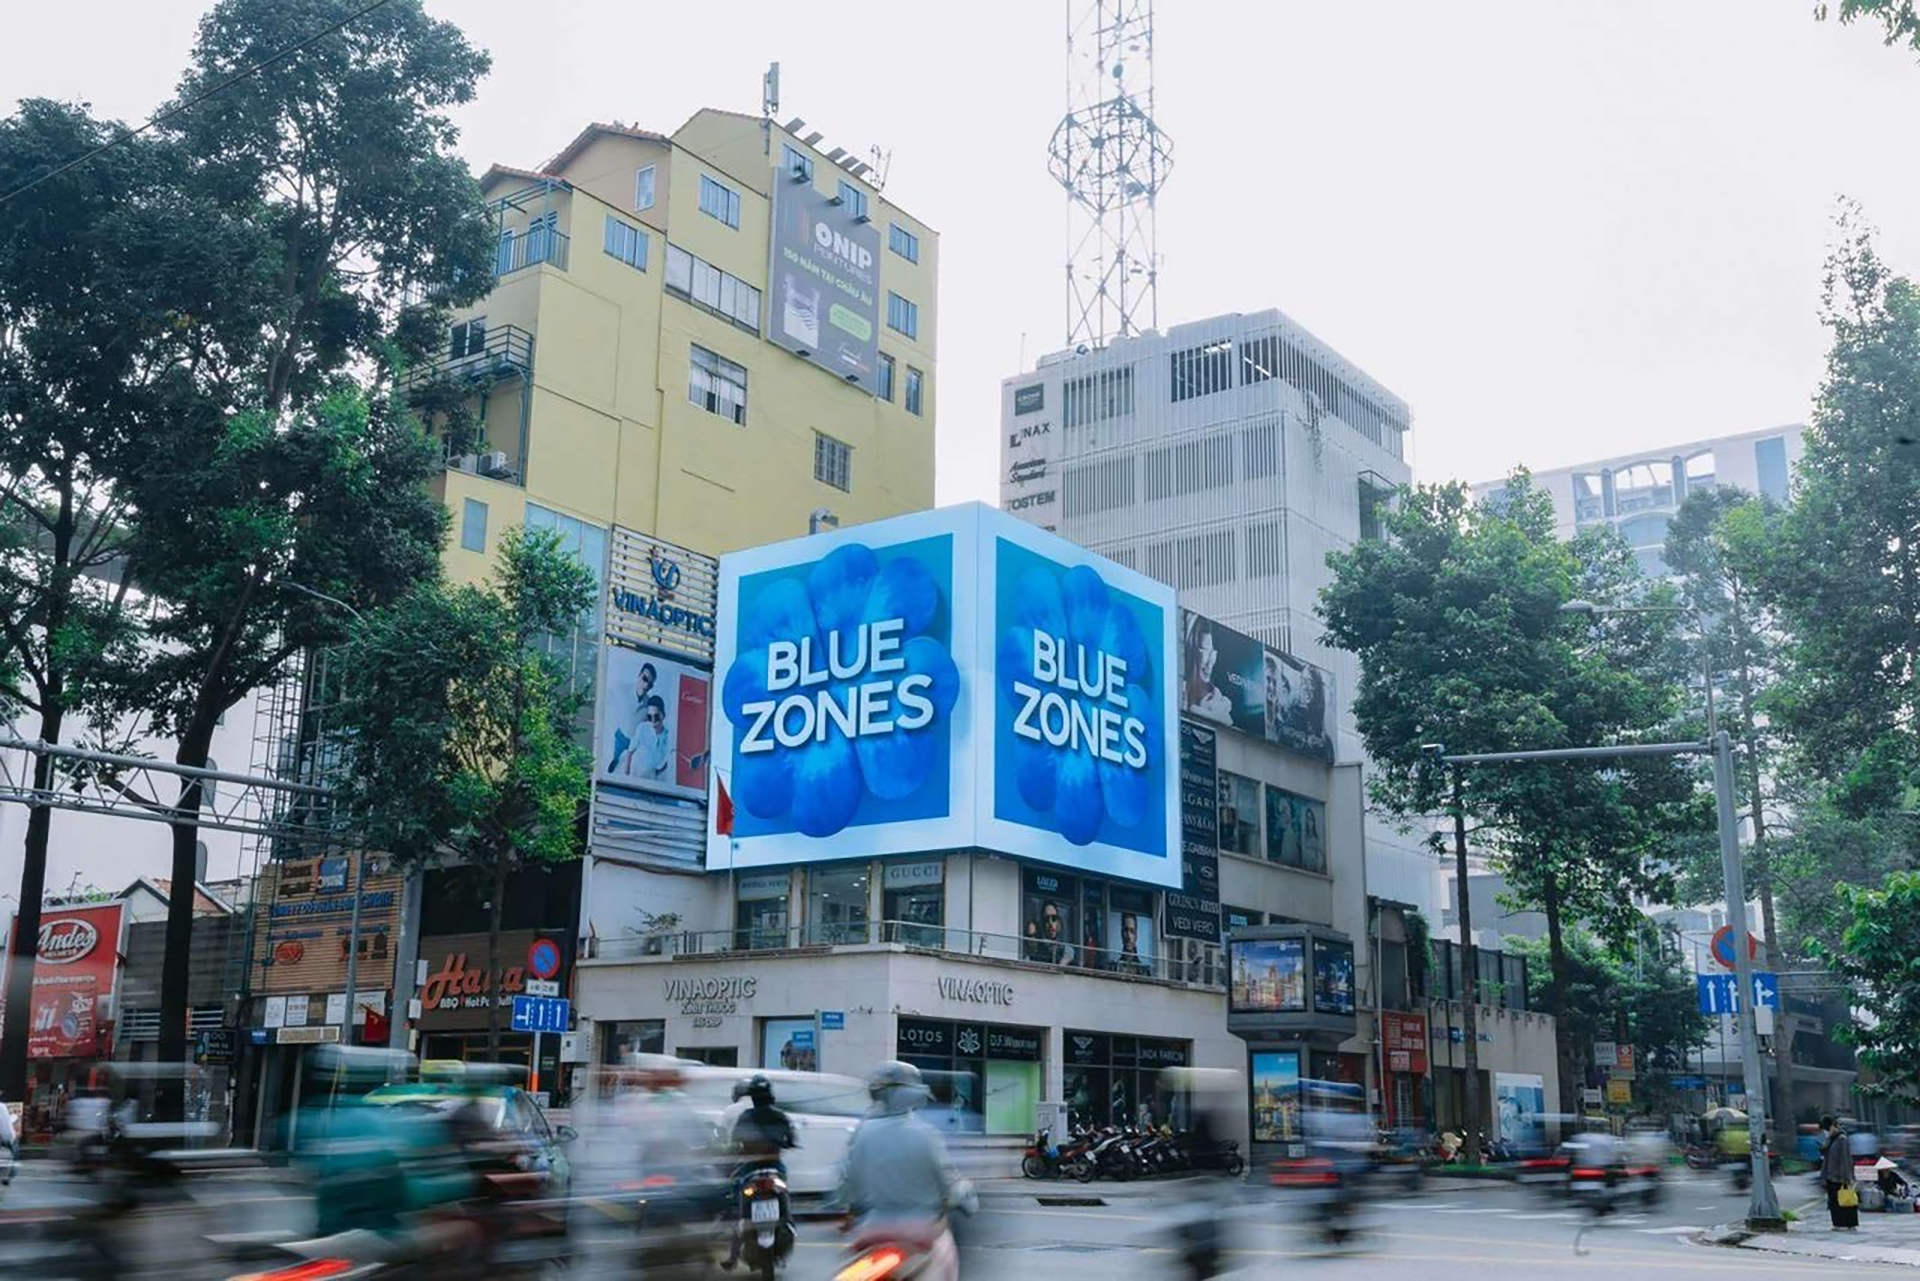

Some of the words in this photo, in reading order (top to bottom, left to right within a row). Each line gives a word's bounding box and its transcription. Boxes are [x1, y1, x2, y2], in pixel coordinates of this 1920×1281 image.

[815, 222, 872, 270] ONIP
[612, 586, 716, 637] VINAOPTIC
[767, 618, 905, 691] BLUE
[1034, 628, 1128, 708] BLUE
[740, 674, 934, 753] ZONES
[1013, 681, 1147, 769] ZONES
[890, 864, 940, 880] GUCCI
[37, 924, 94, 951] Andes
[440, 998, 459, 1009] BBQ
[663, 976, 757, 1001] VINAOPTIC
[937, 976, 1015, 1006] VINAOPTIC
[900, 1028, 943, 1043] LOTOS
